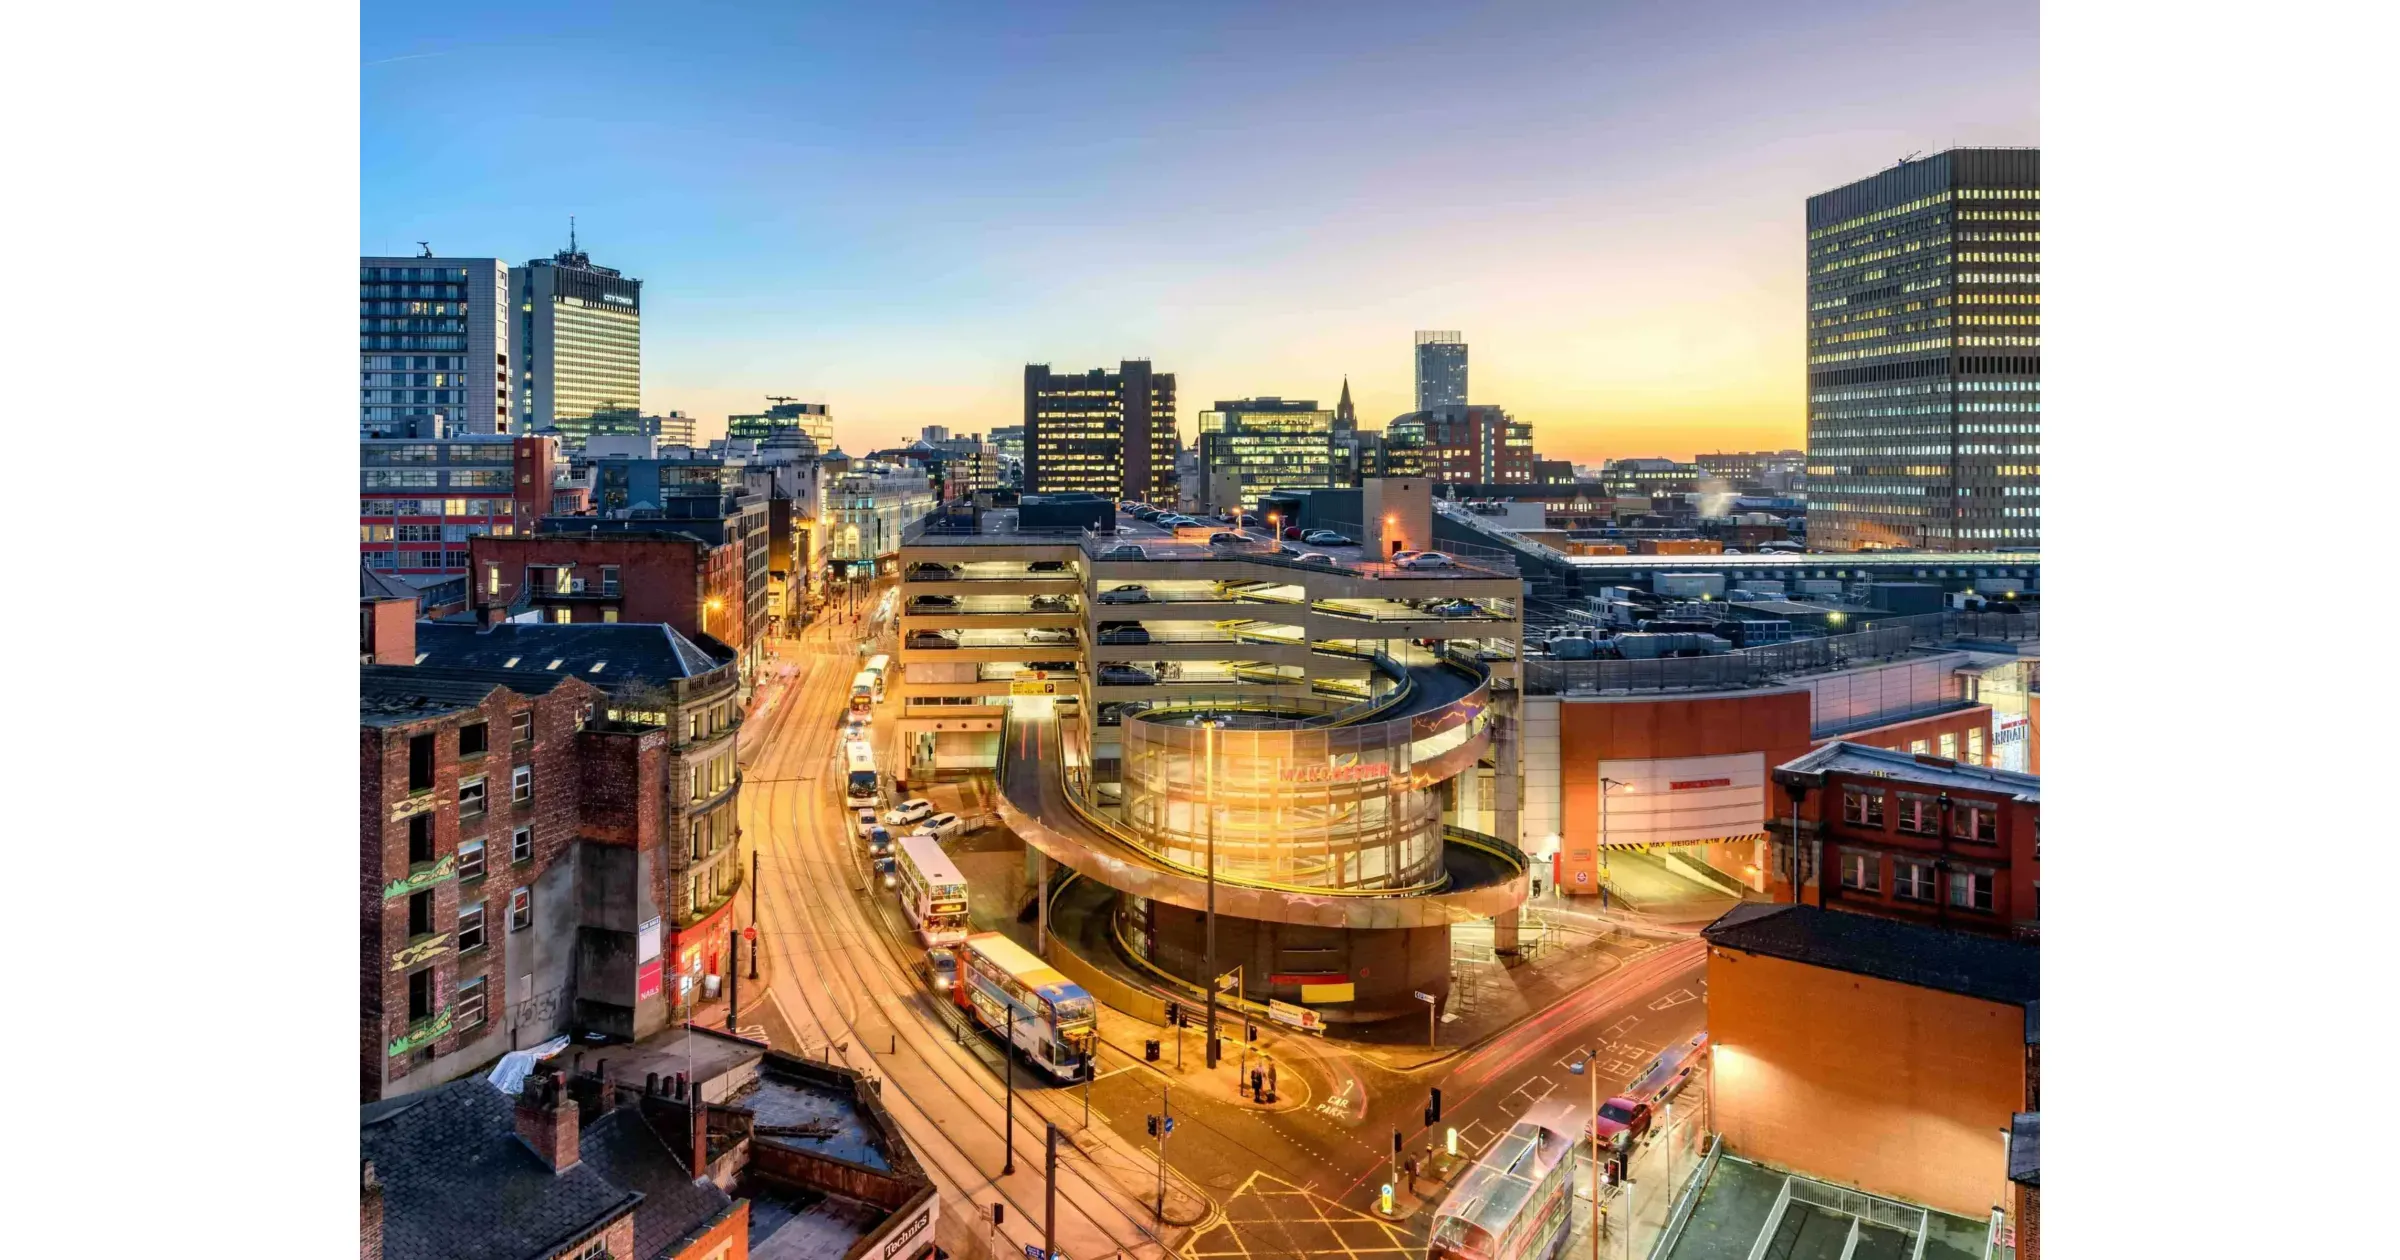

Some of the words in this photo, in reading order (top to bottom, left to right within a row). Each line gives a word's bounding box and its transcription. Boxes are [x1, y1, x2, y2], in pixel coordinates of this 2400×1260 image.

[604, 294, 615, 302] CITY
[1672, 839, 1700, 847] HEIGHT
[640, 985, 660, 1001] NAILS
[736, 1024, 771, 1044] STO
[1327, 1095, 1349, 1108] CAR
[1316, 1103, 1350, 1119] PARK
[885, 1215, 928, 1258] Technics
